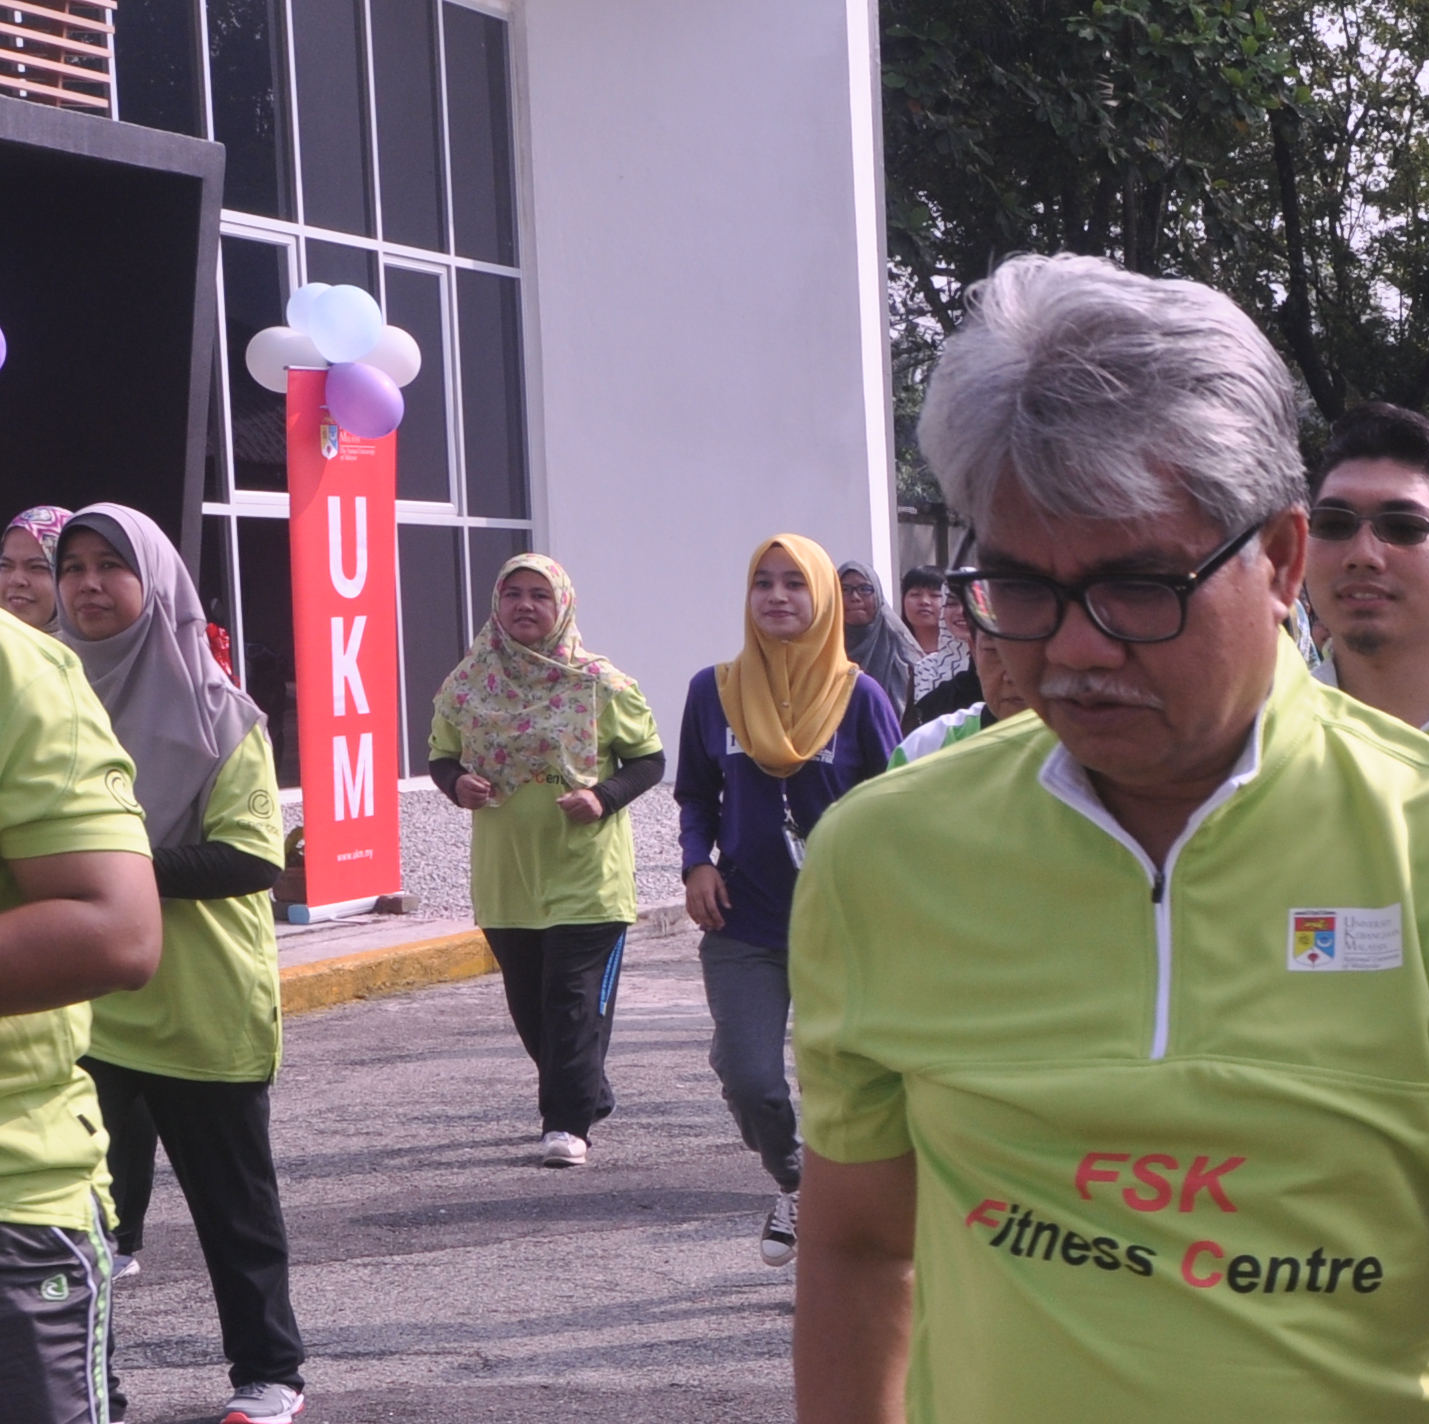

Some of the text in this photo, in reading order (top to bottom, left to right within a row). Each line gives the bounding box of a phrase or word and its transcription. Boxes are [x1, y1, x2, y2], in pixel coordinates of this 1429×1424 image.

[327, 496, 375, 822] UKM
[1075, 1152, 1247, 1213] FSK
[965, 1199, 1383, 1294] Fitness Centre
